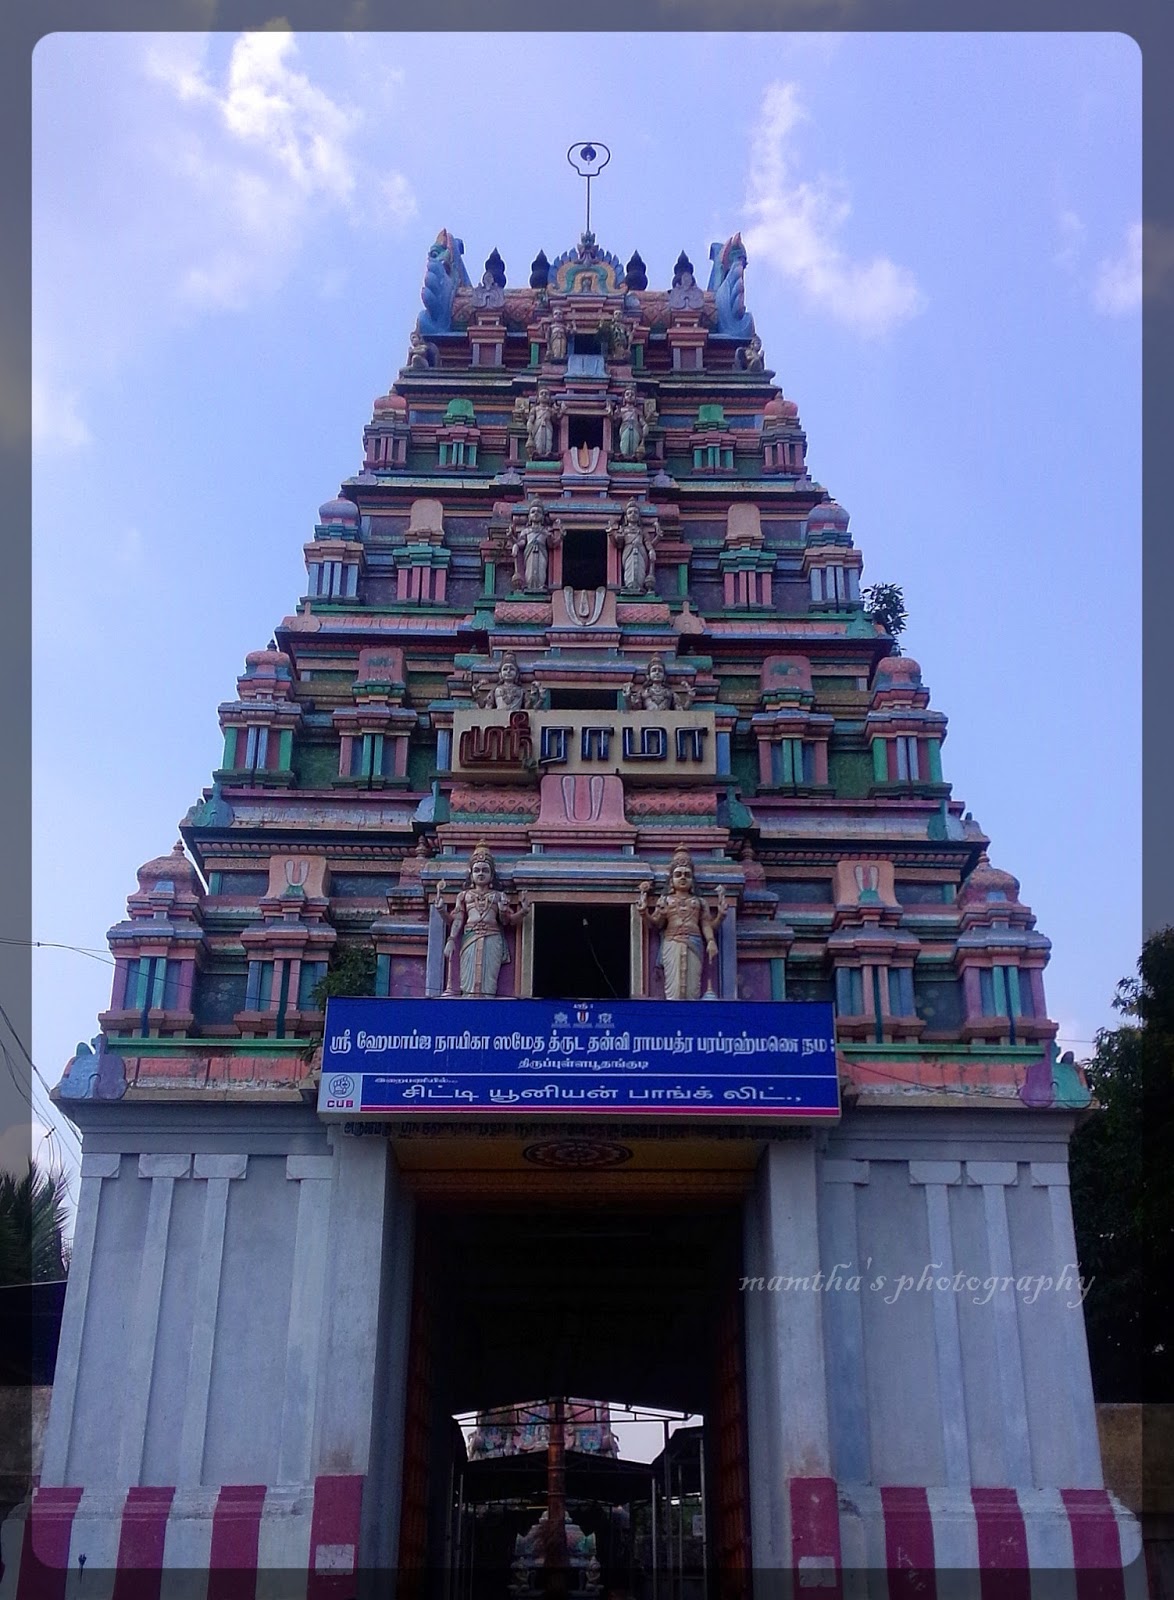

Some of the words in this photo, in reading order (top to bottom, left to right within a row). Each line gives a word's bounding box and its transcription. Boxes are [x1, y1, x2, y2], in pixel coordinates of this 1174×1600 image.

[329, 1029, 352, 1054] ஸ்ரீ
[402, 1084, 479, 1102] சிட்டி
[629, 1085, 713, 1100] பாங்க்
[327, 1100, 354, 1108] CUB
